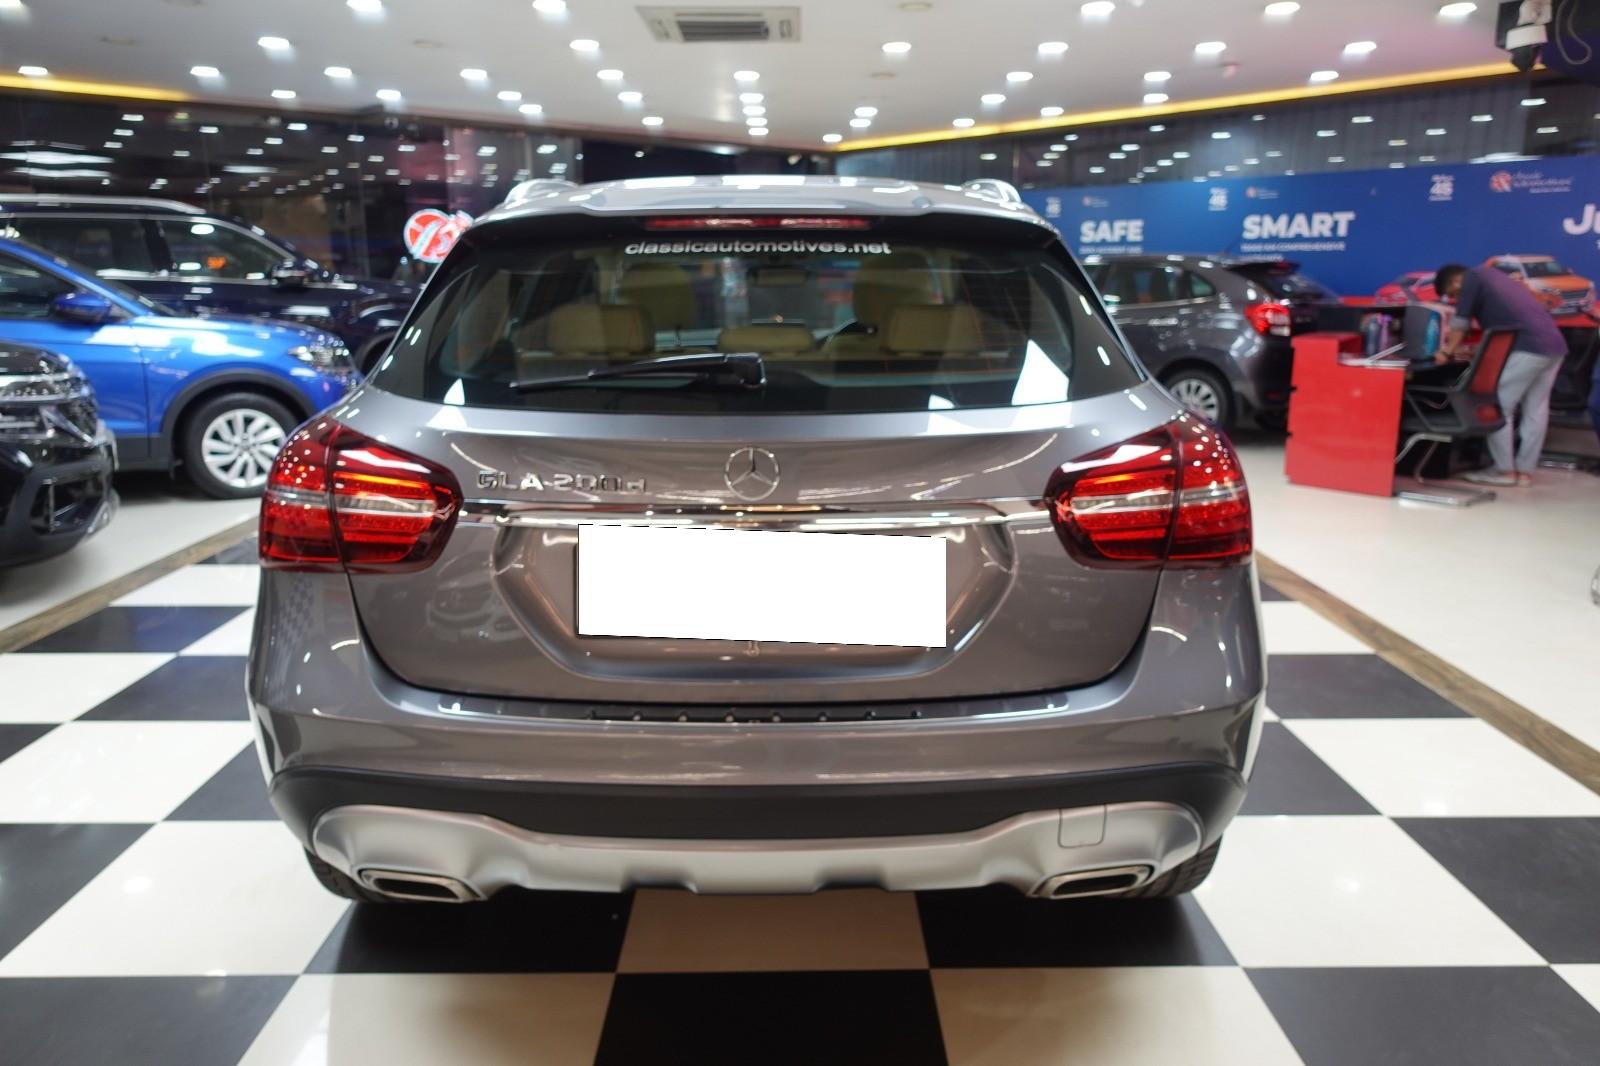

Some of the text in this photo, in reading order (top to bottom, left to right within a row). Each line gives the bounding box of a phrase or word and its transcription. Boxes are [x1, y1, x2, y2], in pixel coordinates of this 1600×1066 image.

[1080, 219, 1144, 243] SAFE
[1242, 211, 1355, 239] SMART
[624, 240, 892, 255] classicautomotives.net
[477, 470, 544, 491] GLA
